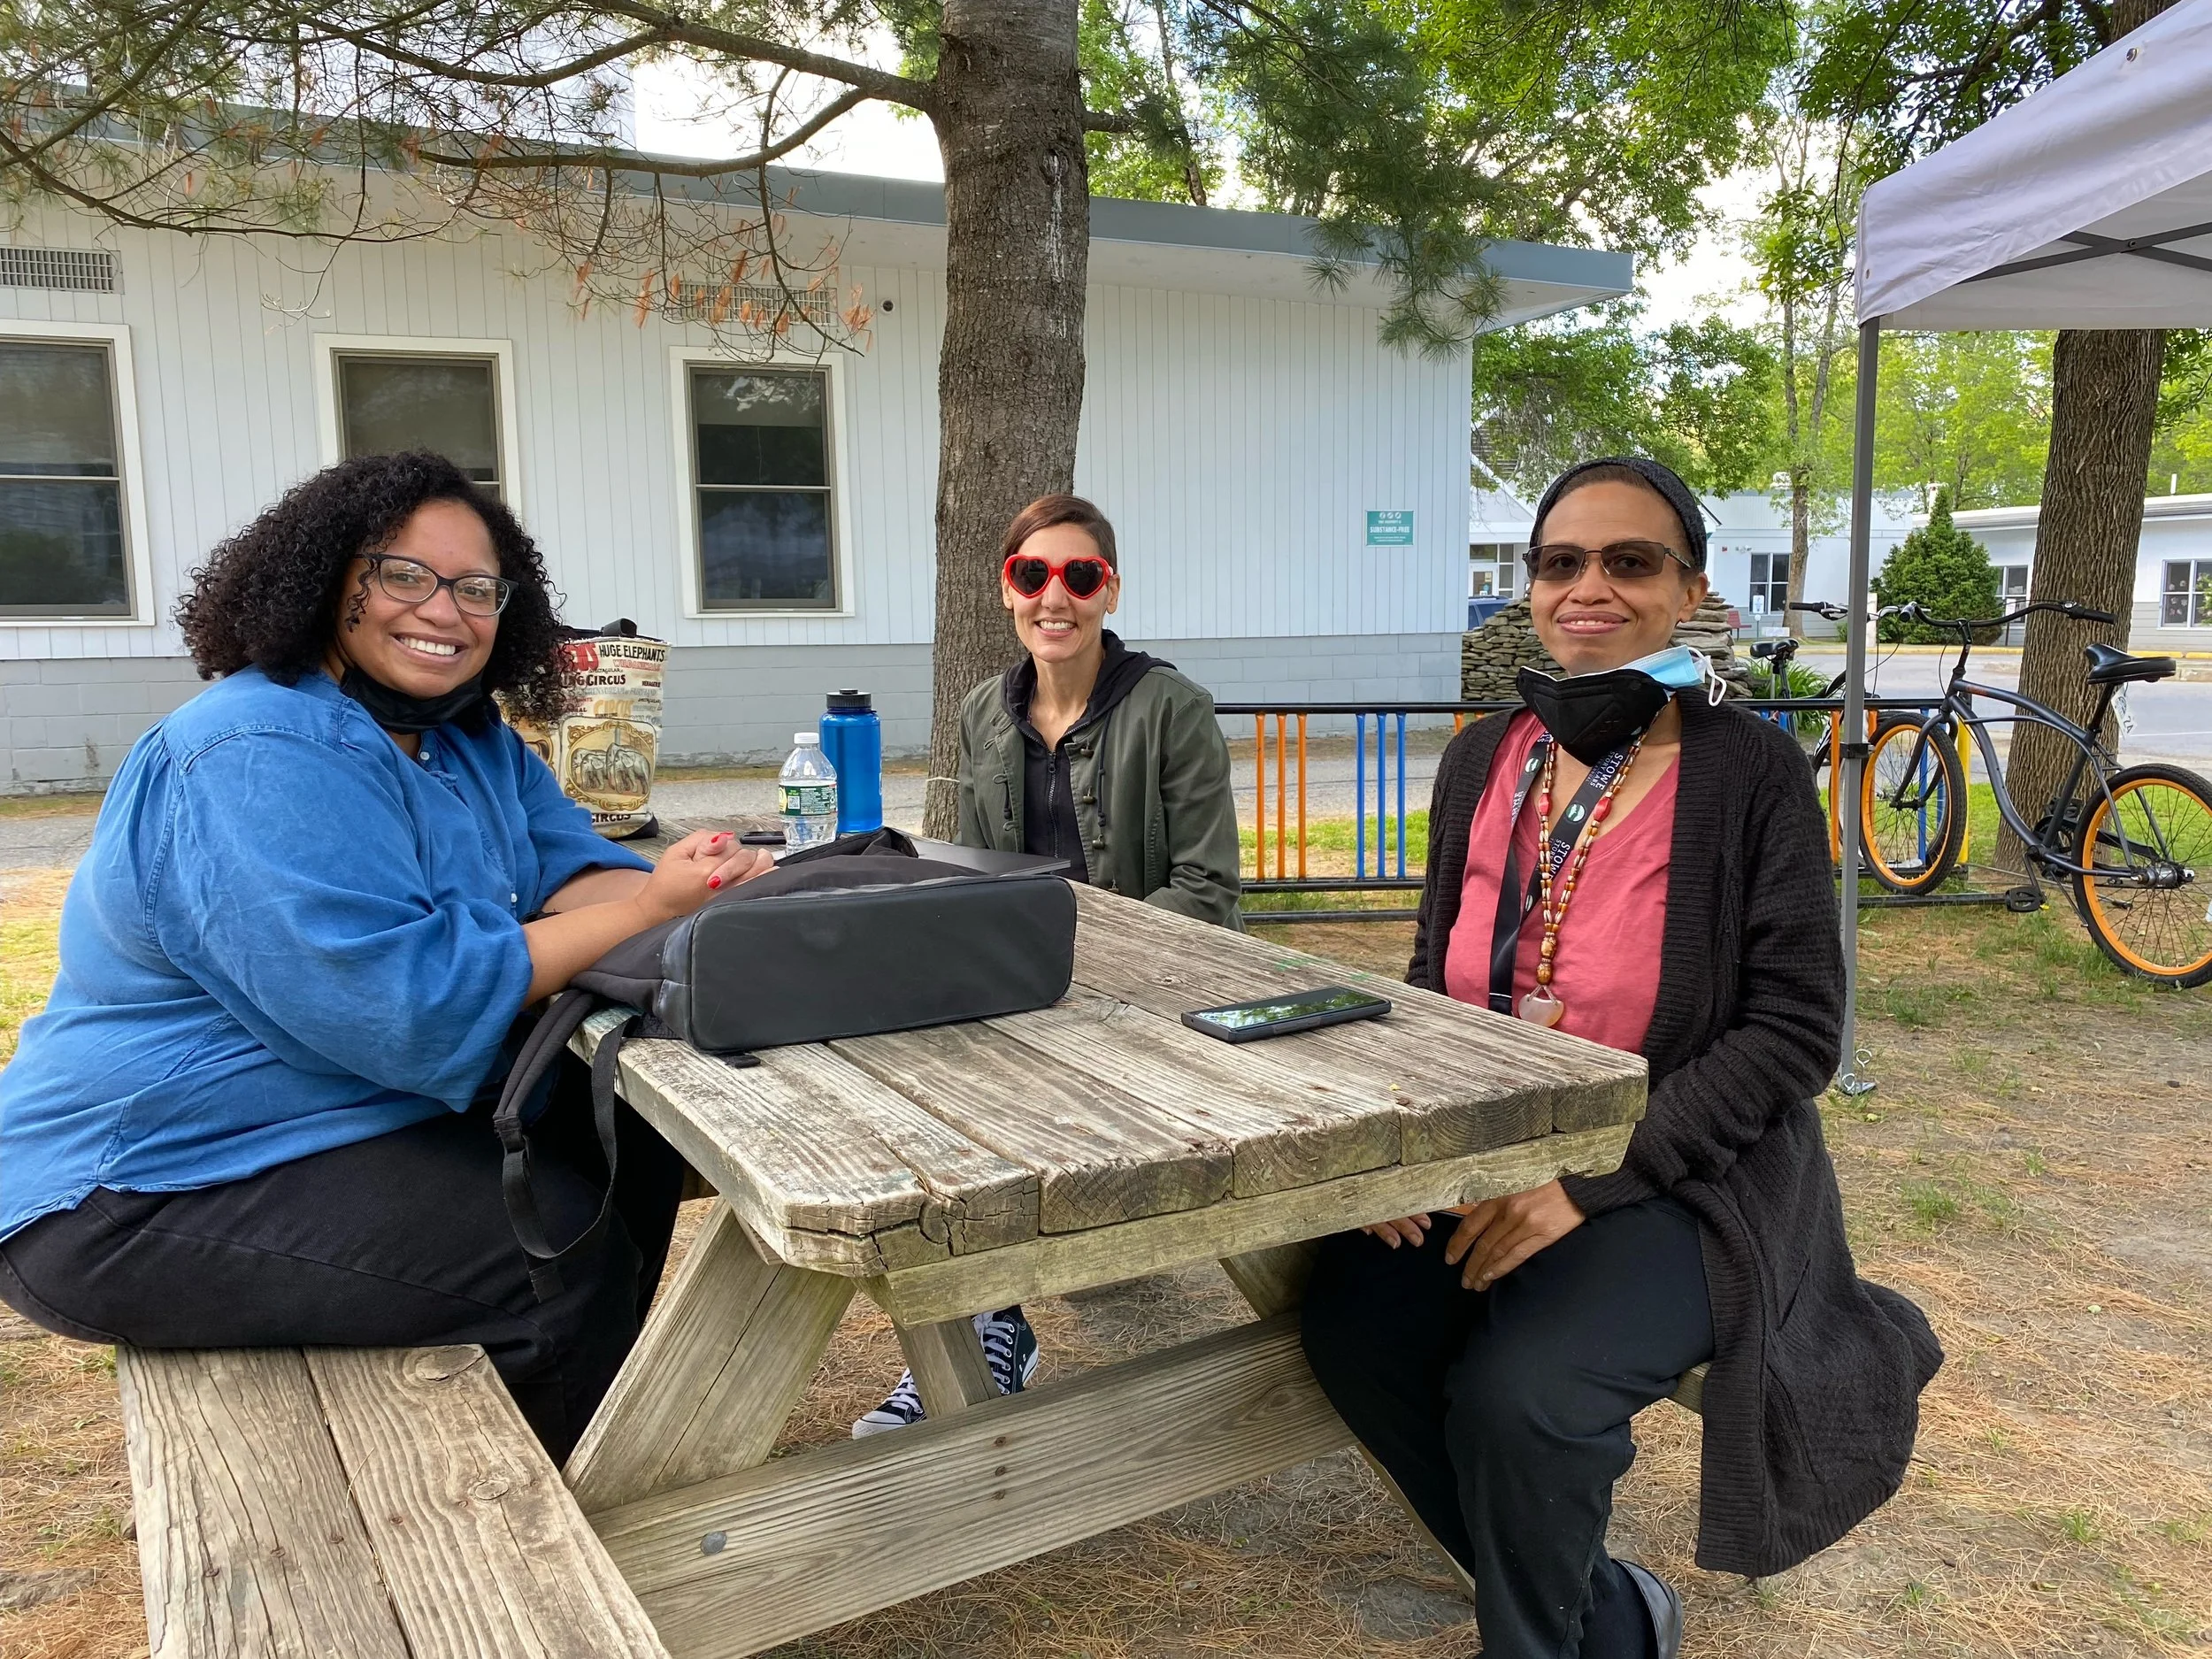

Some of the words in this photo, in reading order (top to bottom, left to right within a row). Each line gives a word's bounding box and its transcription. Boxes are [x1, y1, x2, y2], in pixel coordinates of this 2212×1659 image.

[599, 644, 621, 657] HUGE
[623, 645, 665, 662] ELEPHANTS
[587, 674, 626, 686] CIRCUS
[1601, 751, 1615, 771] STORY
[1590, 771, 1602, 787] LABS
[1595, 753, 1624, 790] STOWE
